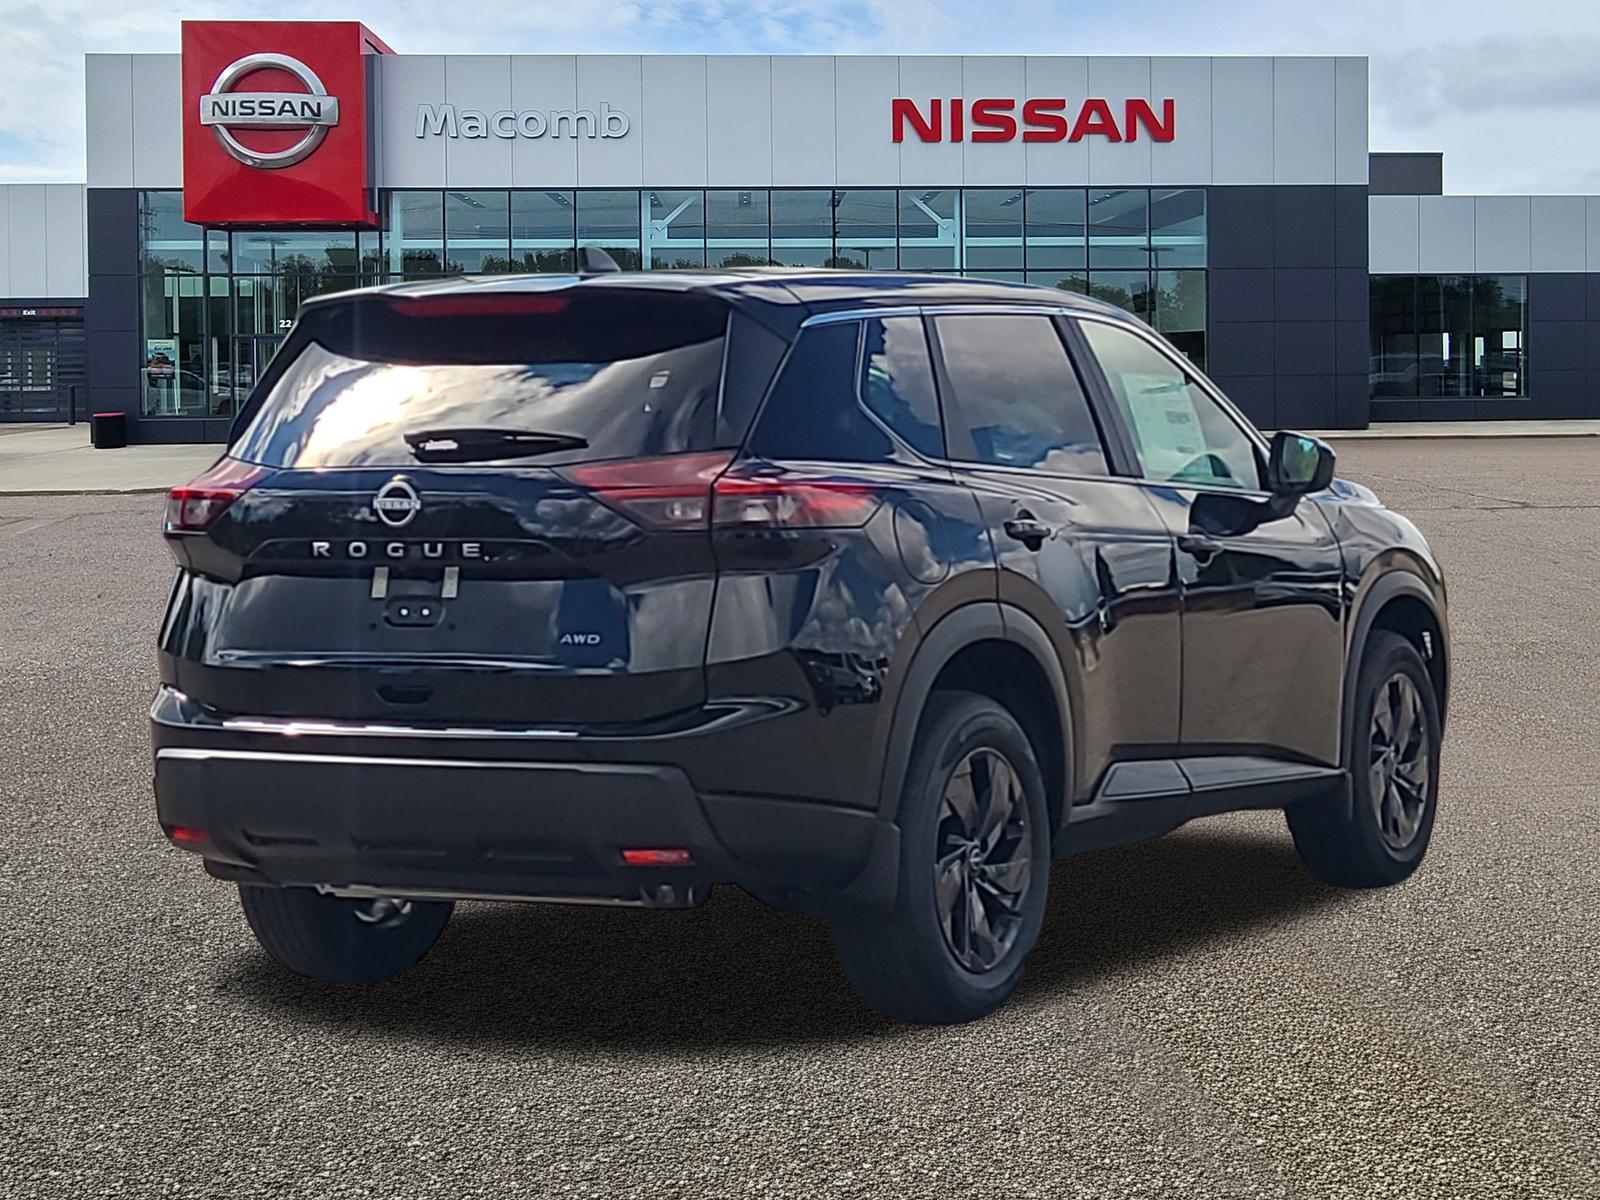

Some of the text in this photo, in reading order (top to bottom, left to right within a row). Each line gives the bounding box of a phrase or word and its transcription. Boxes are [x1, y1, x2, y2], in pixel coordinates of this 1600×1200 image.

[211, 100, 322, 117] NISSAN
[415, 102, 630, 139] Macomb
[892, 98, 1175, 143] NISSAN
[279, 319, 295, 328] 22
[312, 541, 481, 558] ROGUE
[560, 633, 601, 645] AWD
